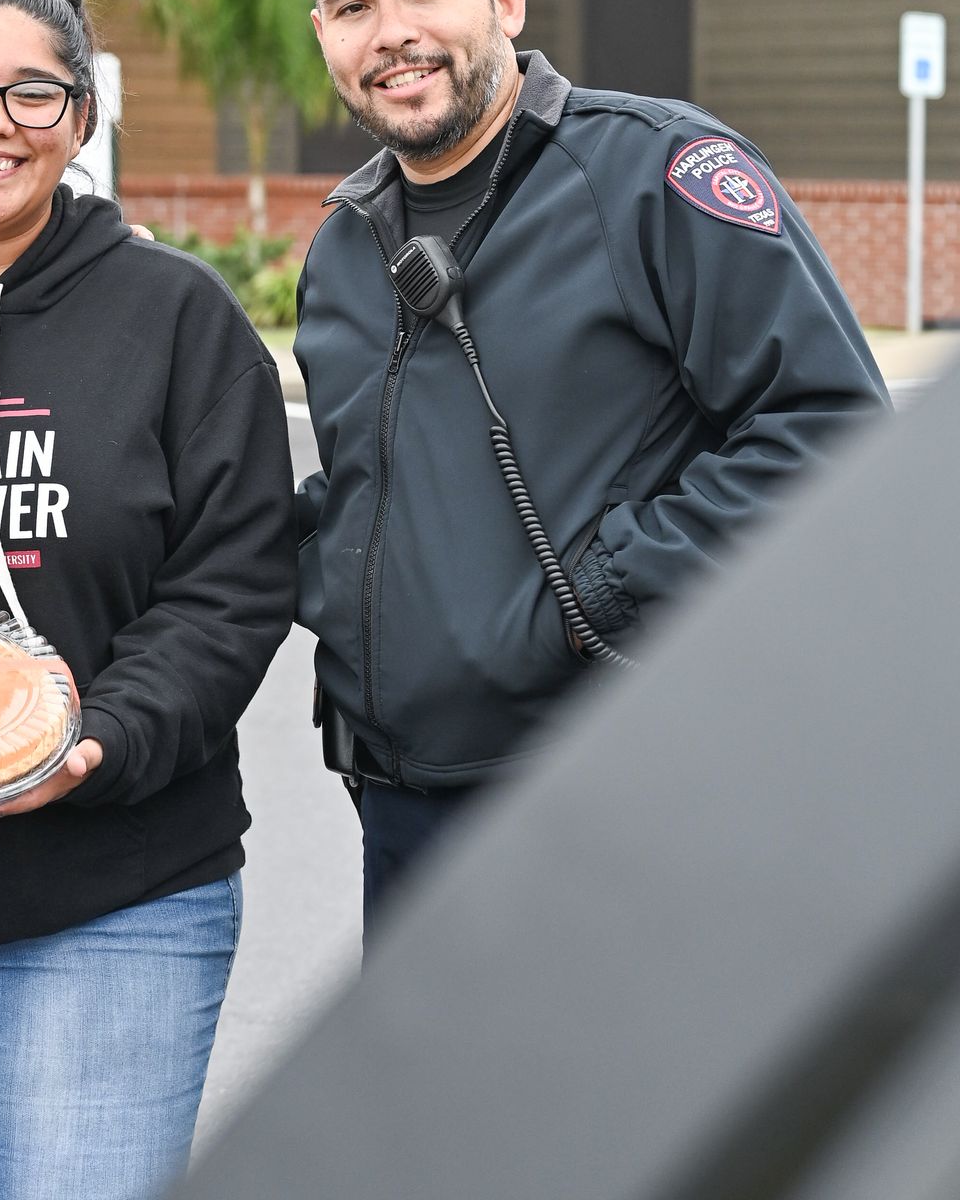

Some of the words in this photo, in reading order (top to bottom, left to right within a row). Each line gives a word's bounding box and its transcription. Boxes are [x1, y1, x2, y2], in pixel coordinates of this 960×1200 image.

[671, 142, 735, 179] HARLINGEN
[691, 153, 738, 180] POLICE
[748, 208, 775, 223] TEXAS
